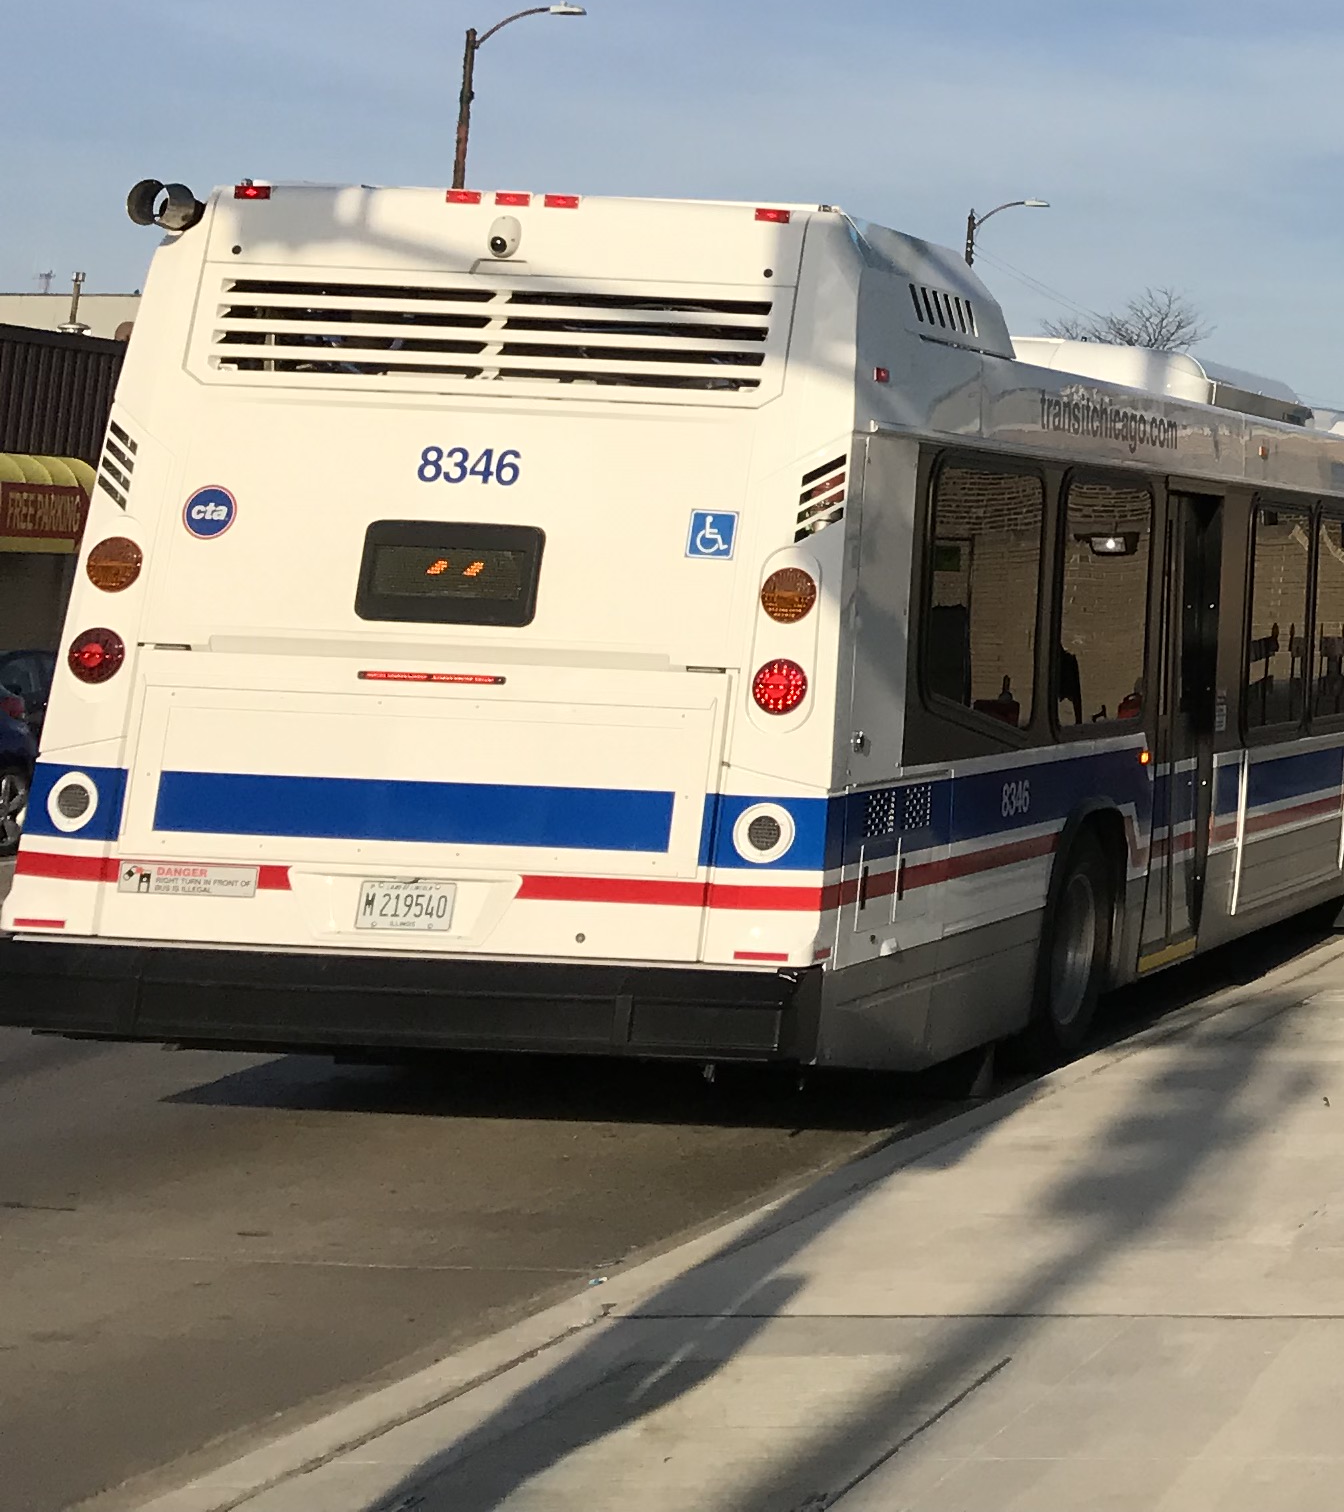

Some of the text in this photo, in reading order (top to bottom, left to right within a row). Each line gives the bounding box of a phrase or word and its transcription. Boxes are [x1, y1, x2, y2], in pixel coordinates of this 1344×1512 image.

[1040, 389, 1178, 454] transitchicago.com
[417, 445, 522, 486] 8346
[7, 491, 81, 533] FREE PARKING
[191, 502, 228, 521] cta
[1001, 779, 1030, 817] 8346
[155, 877, 179, 885] RIGHT
[213, 879, 240, 887] FRONT
[156, 866, 208, 878] DANGER
[181, 886, 212, 894] ILLEGAL
[363, 893, 447, 918] M 219540
